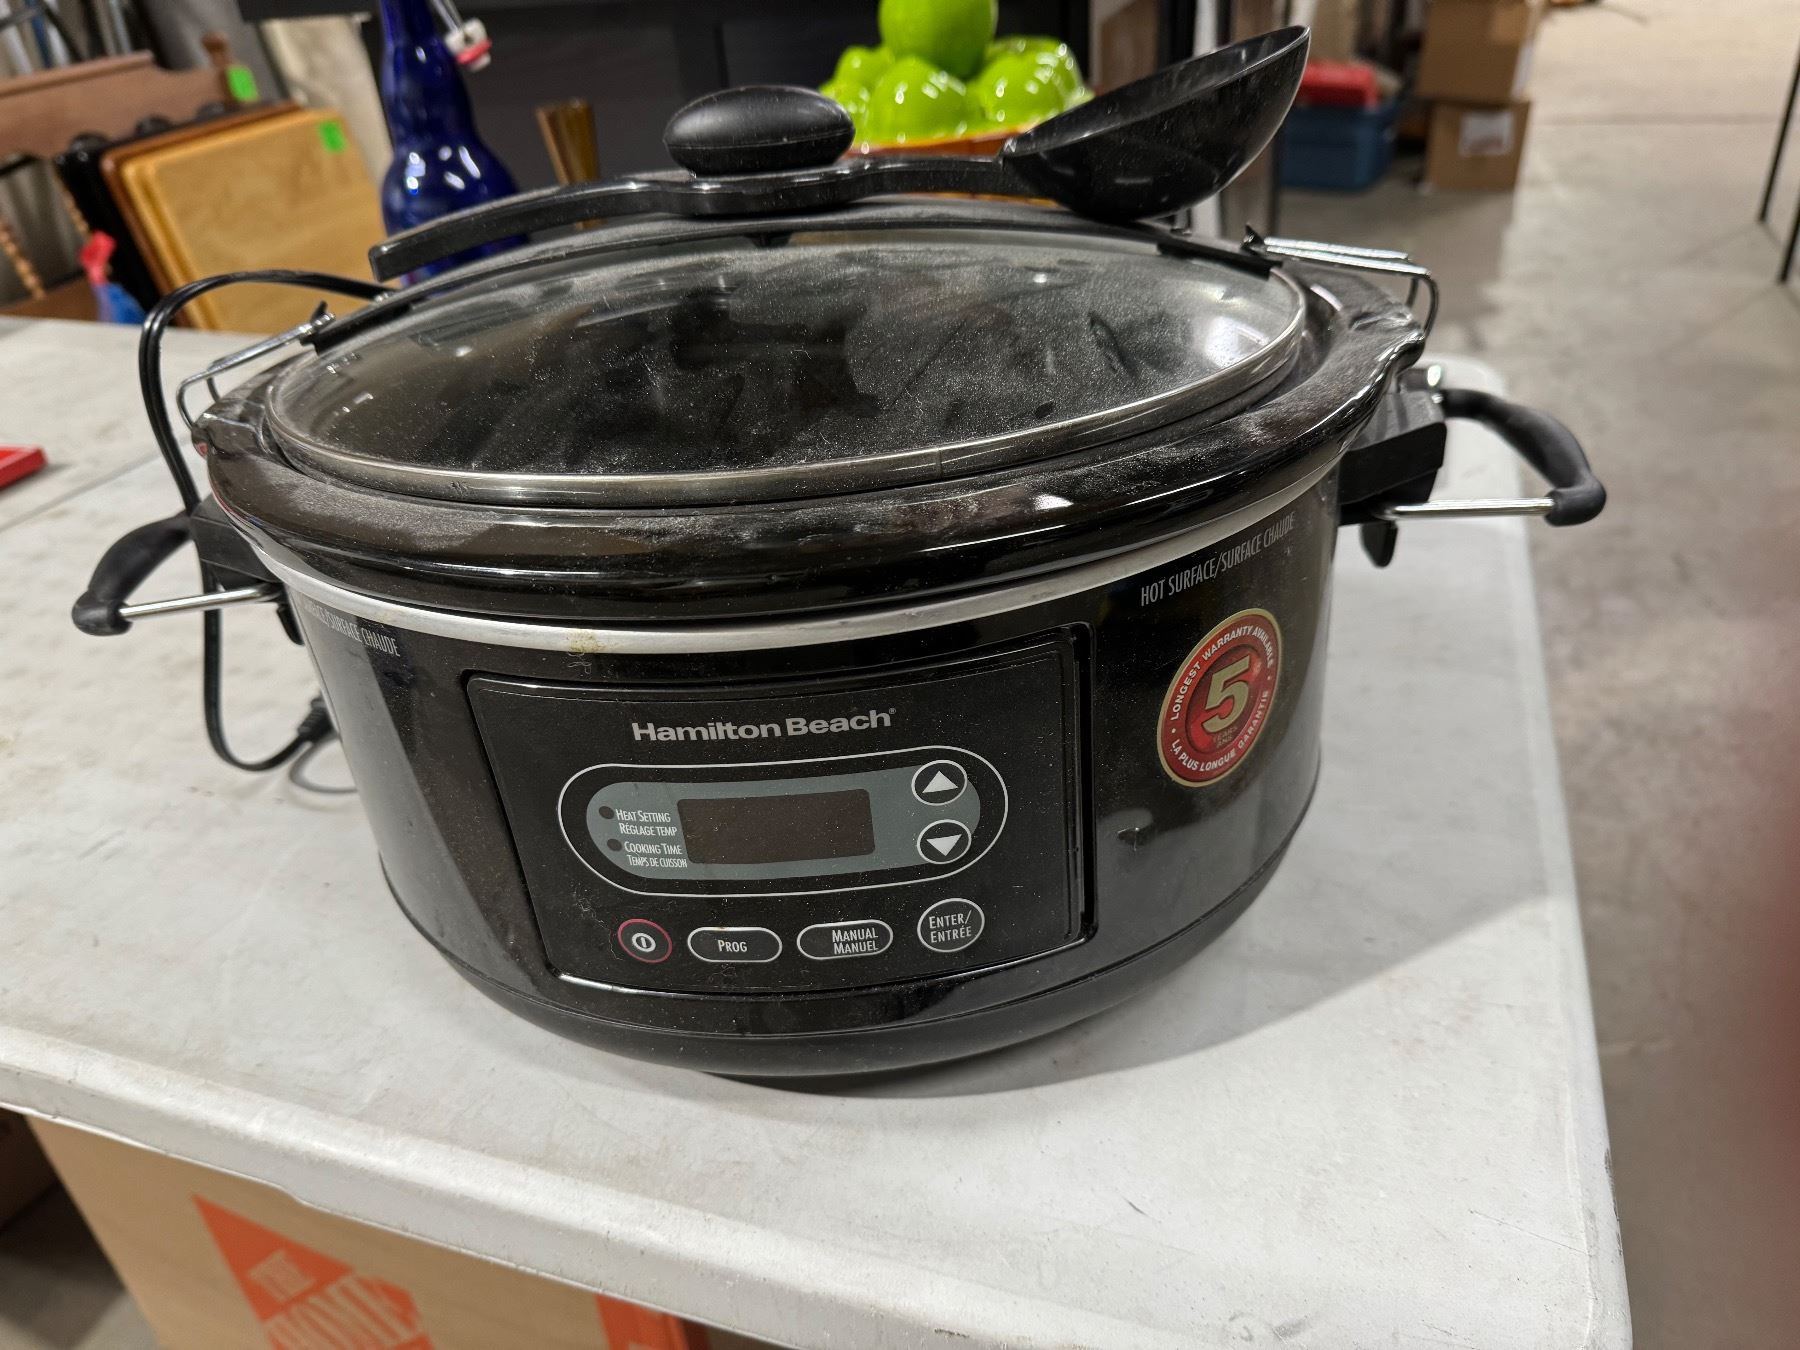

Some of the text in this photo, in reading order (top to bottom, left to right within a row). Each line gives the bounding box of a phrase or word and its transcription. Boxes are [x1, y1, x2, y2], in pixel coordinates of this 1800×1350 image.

[1141, 578, 1166, 607] HOT
[1263, 511, 1296, 548] CHAUDE
[361, 627, 400, 657] CHAUDE
[1171, 625, 1274, 720] LONGEST WARRANTY AVAILABLE
[1202, 654, 1251, 733] 5
[632, 722, 782, 741] Hamilton
[1171, 690, 1269, 772] LA PLUS LONGUE GARANTIE
[615, 808, 671, 823] HEAT SETTING
[619, 822, 678, 837] RÉGLAGE TEMP
[624, 841, 683, 855] COOKING TIME
[626, 854, 688, 868] TEMPS DE CUISSON
[929, 909, 972, 929] ENTER/
[832, 927, 878, 943] MANUAL
[930, 925, 972, 944] ENTRÉE
[717, 939, 748, 952] PROG
[833, 940, 878, 955] MANUEL
